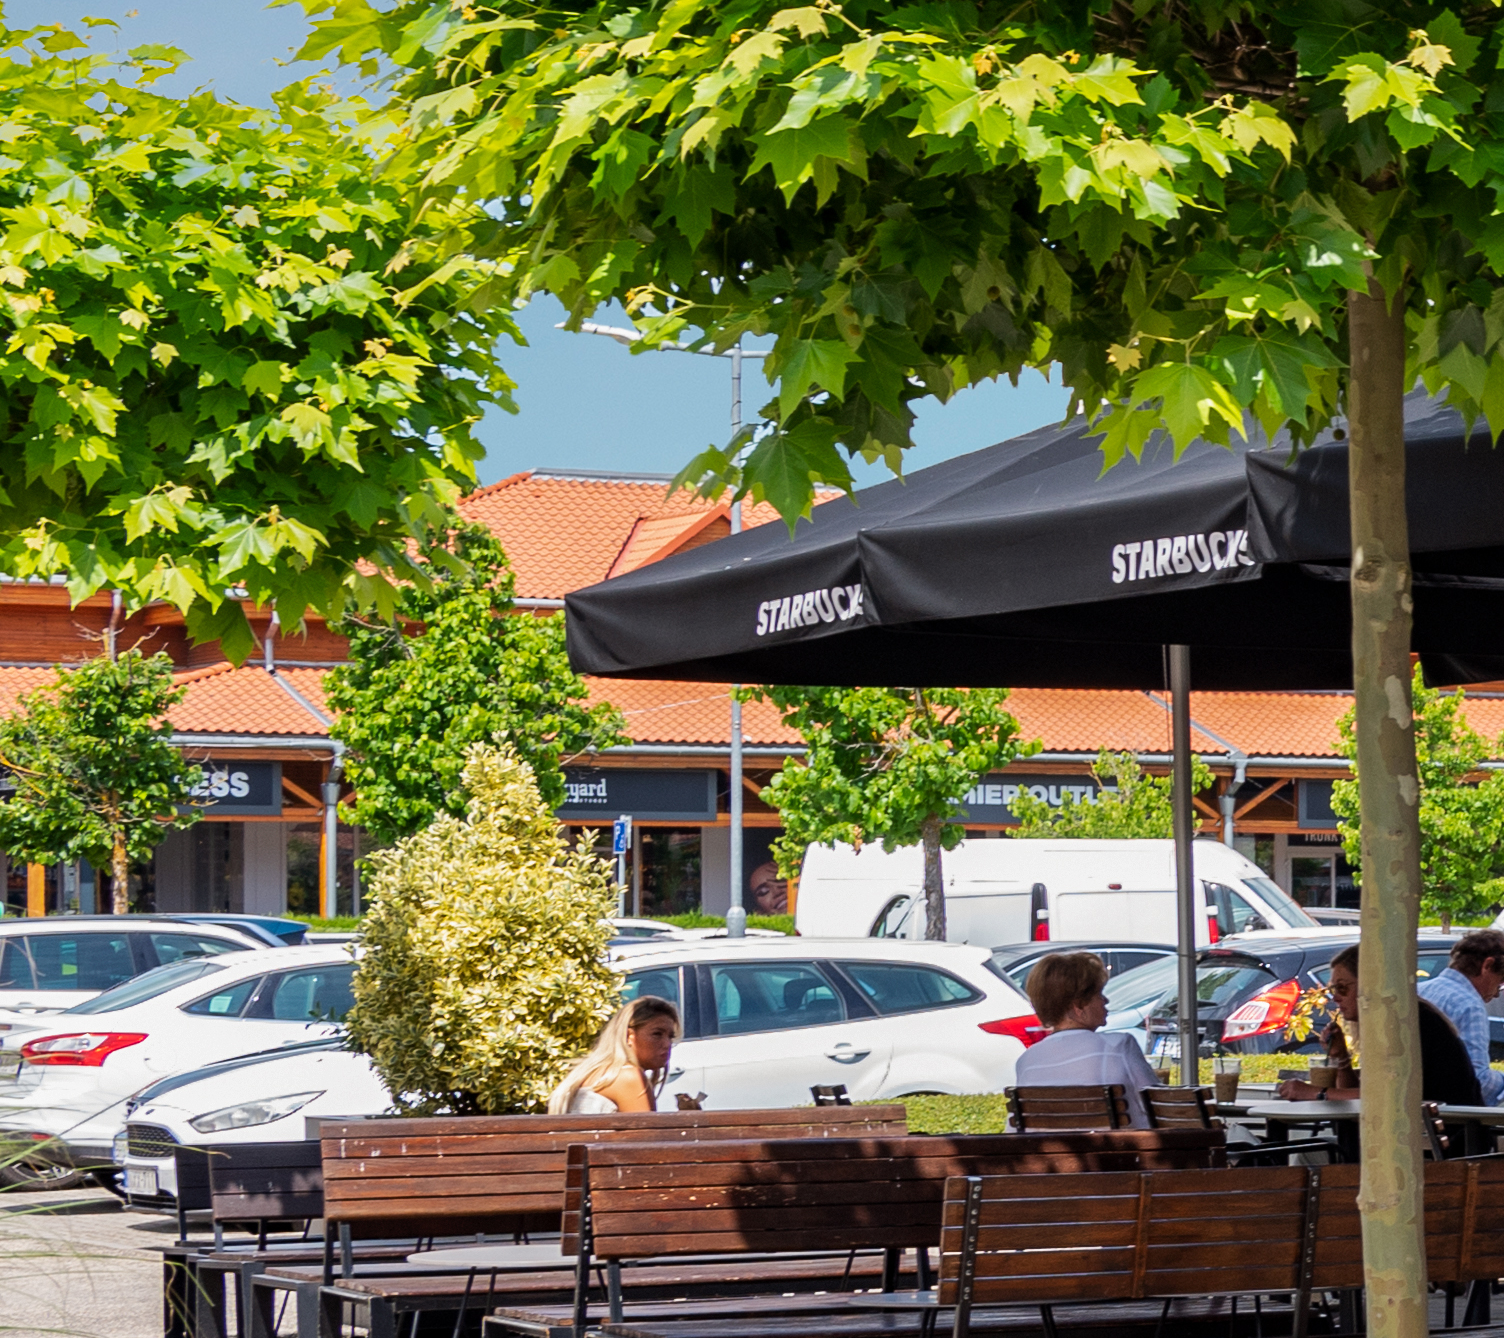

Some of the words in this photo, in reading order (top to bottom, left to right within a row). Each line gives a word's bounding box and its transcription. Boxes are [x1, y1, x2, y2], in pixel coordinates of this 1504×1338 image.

[756, 583, 864, 636] STARBUCK
[174, 770, 250, 798] ESS
[946, 784, 1018, 805] MIER
[1028, 784, 1119, 806] OUTL
